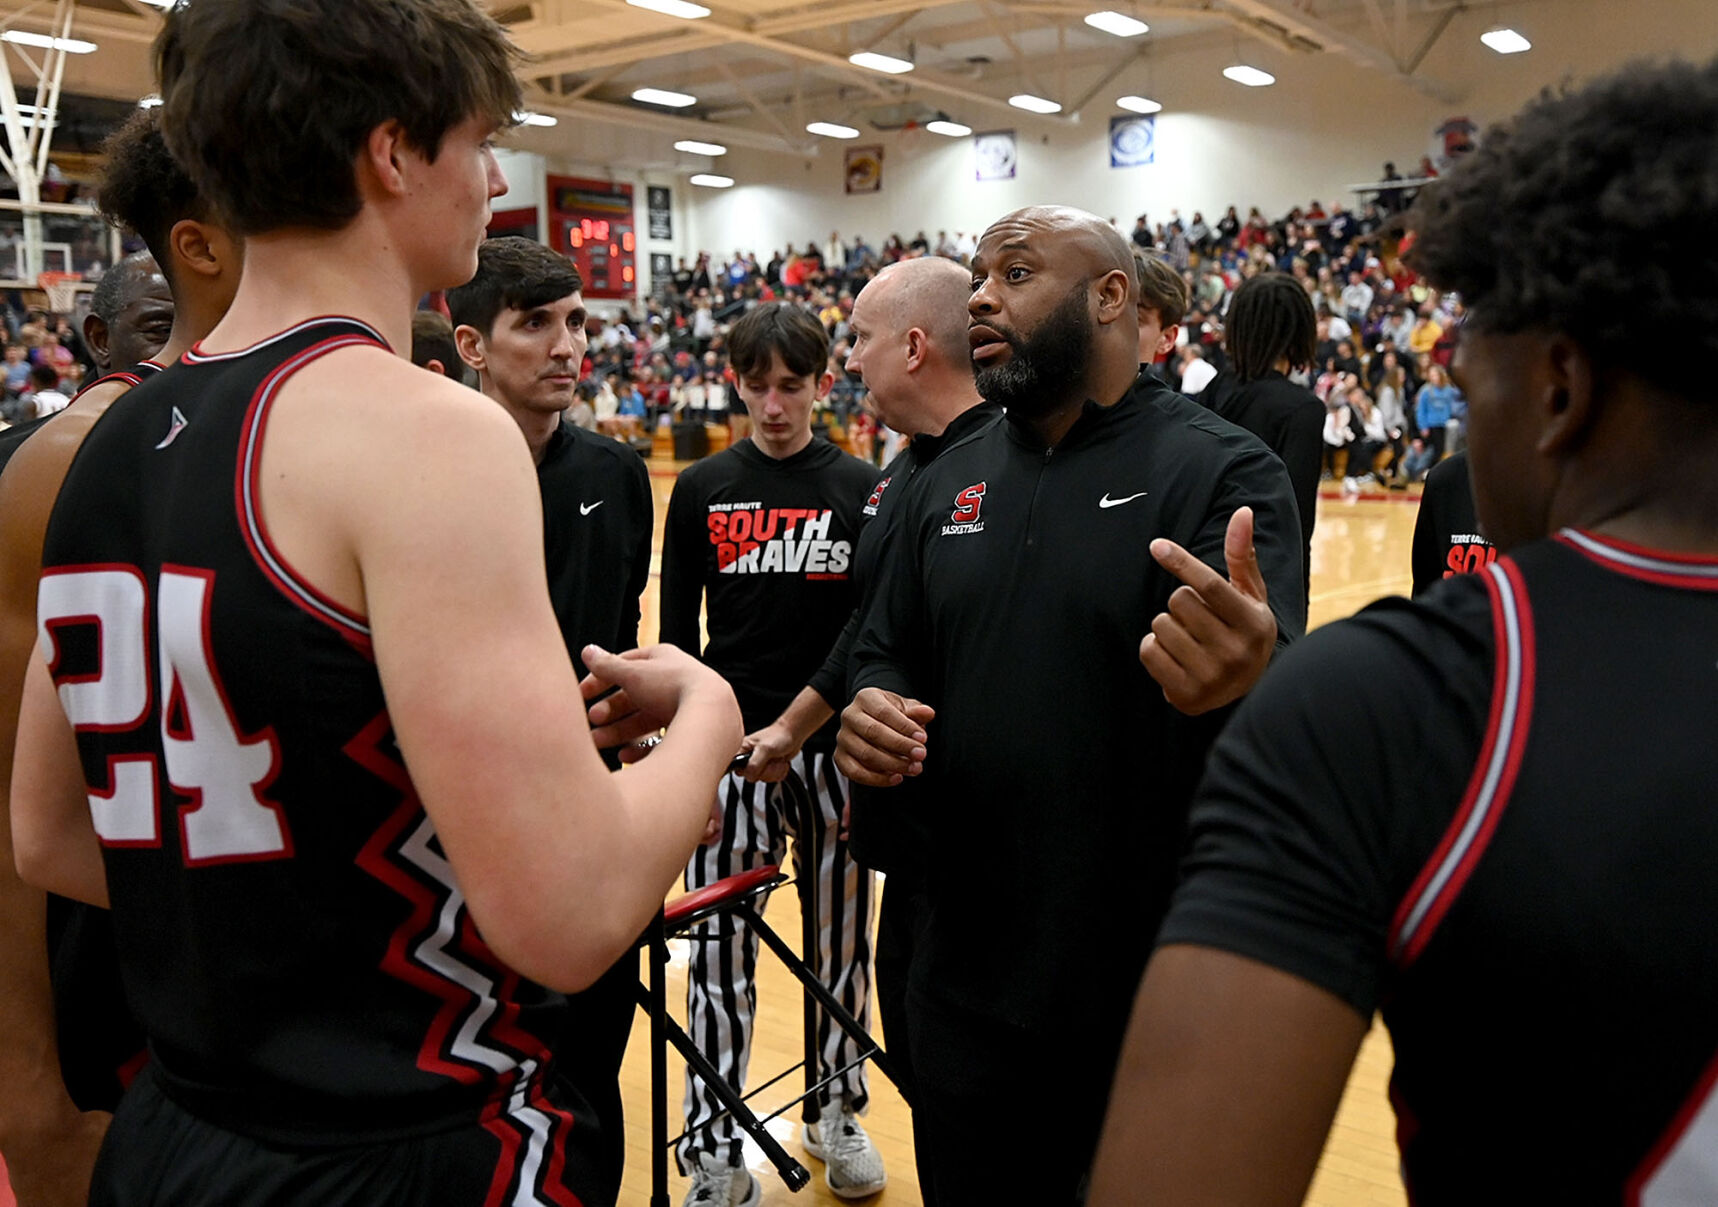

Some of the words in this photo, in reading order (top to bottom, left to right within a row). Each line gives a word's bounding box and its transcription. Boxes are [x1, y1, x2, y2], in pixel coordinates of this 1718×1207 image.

[733, 501, 762, 510] HAUTE
[951, 481, 986, 523] S
[707, 508, 832, 545] SOUTH
[941, 521, 985, 536] BASKETBALL
[717, 539, 852, 574] BRAVES
[37, 562, 294, 868] 24
